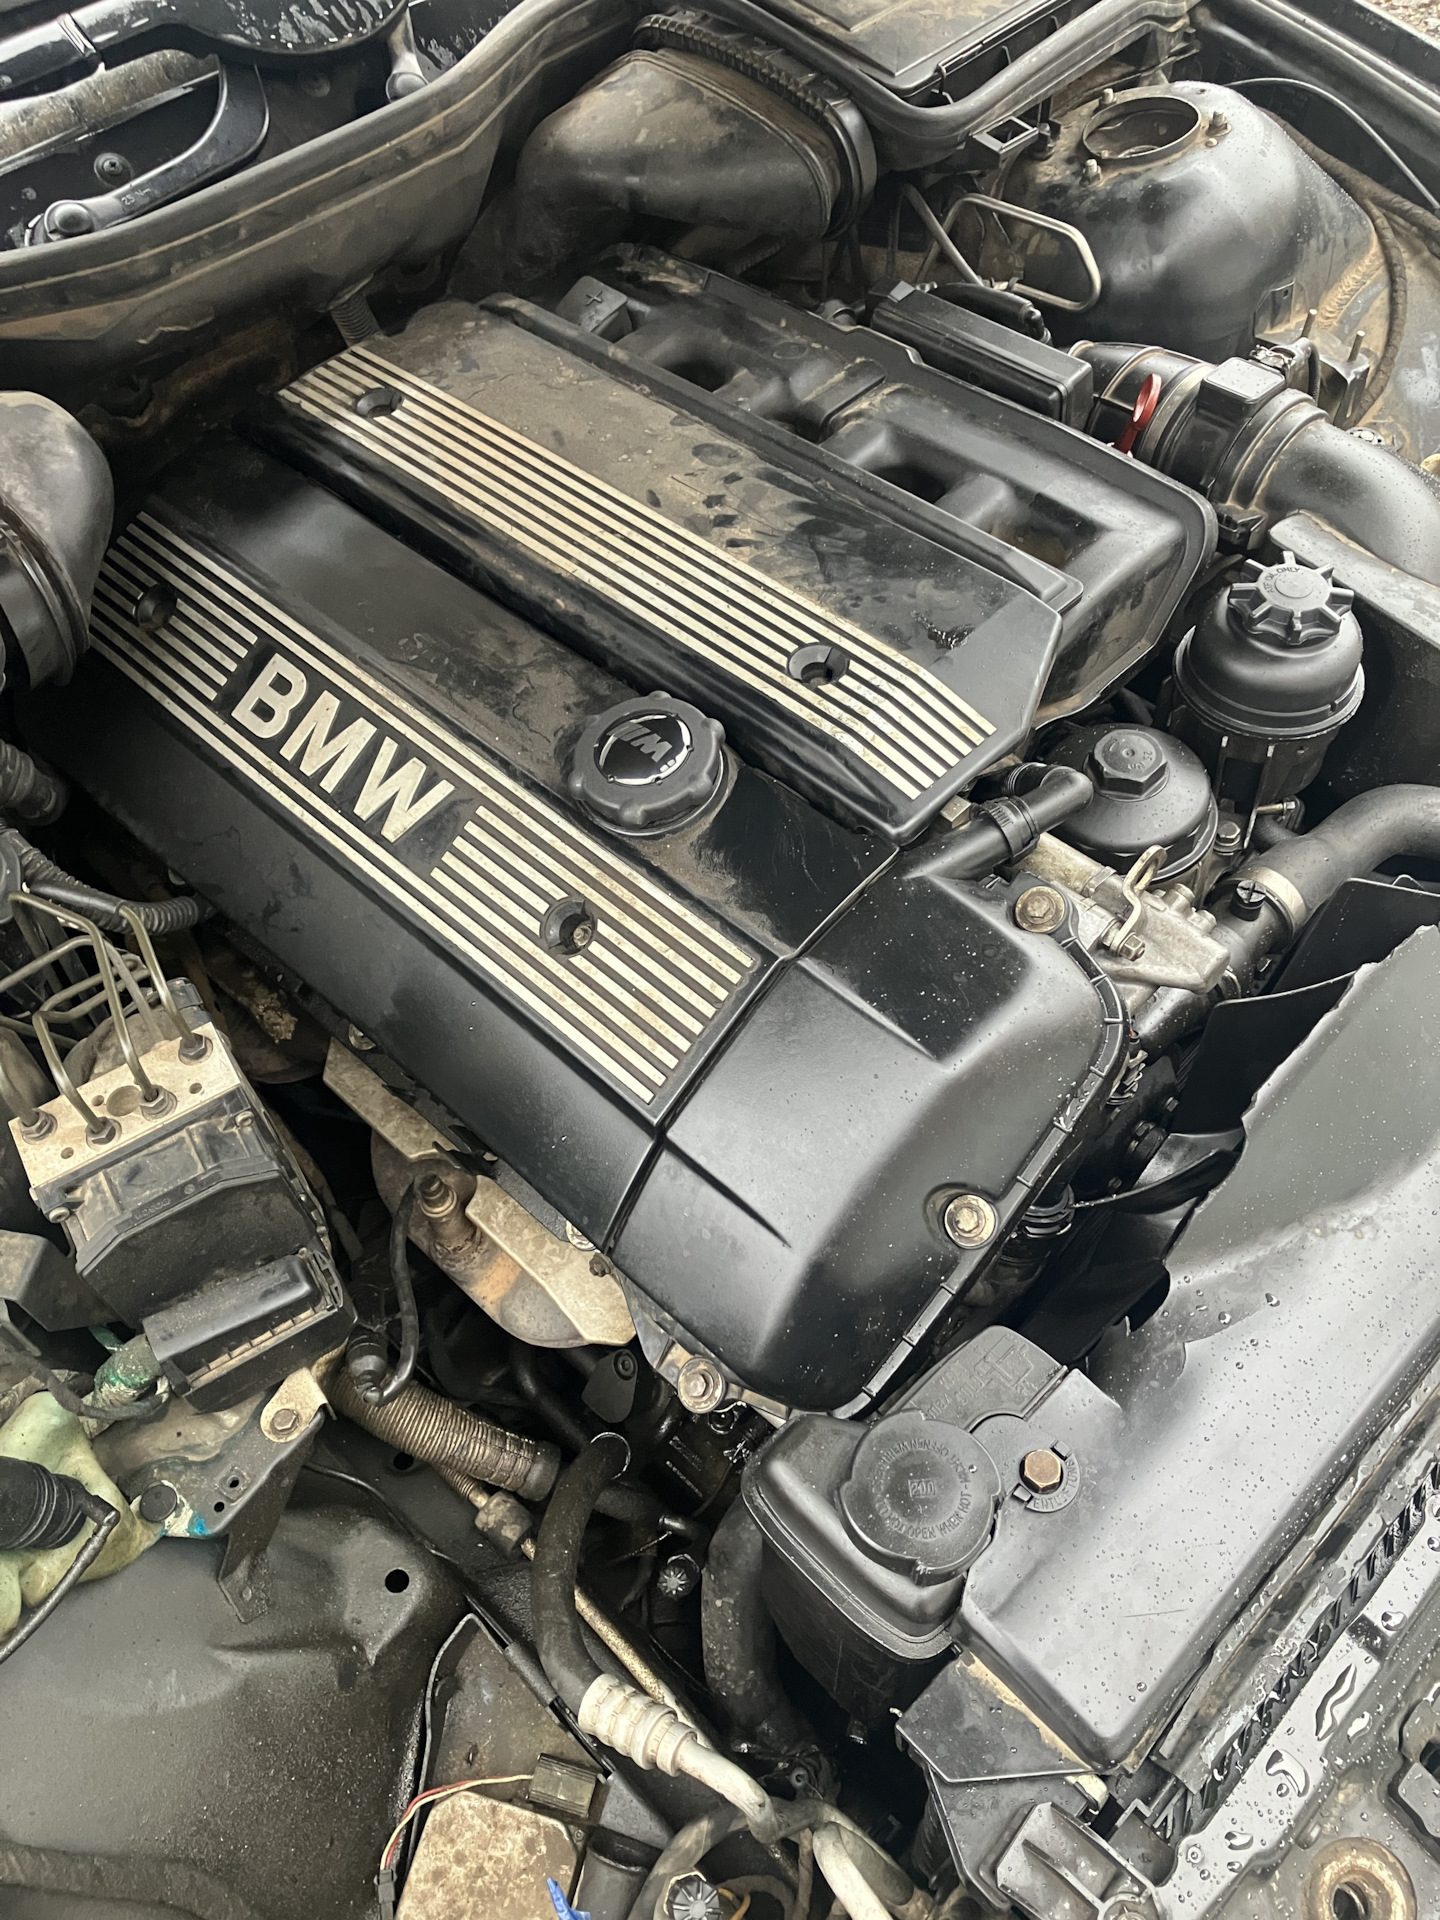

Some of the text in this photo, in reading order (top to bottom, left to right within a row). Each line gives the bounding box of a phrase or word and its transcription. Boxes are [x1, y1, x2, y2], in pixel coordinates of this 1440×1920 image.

[1263, 582, 1275, 594] ATF
[231, 652, 456, 844] BMW
[909, 1526, 936, 1540] OPEN
[958, 1491, 973, 1515] HOT
